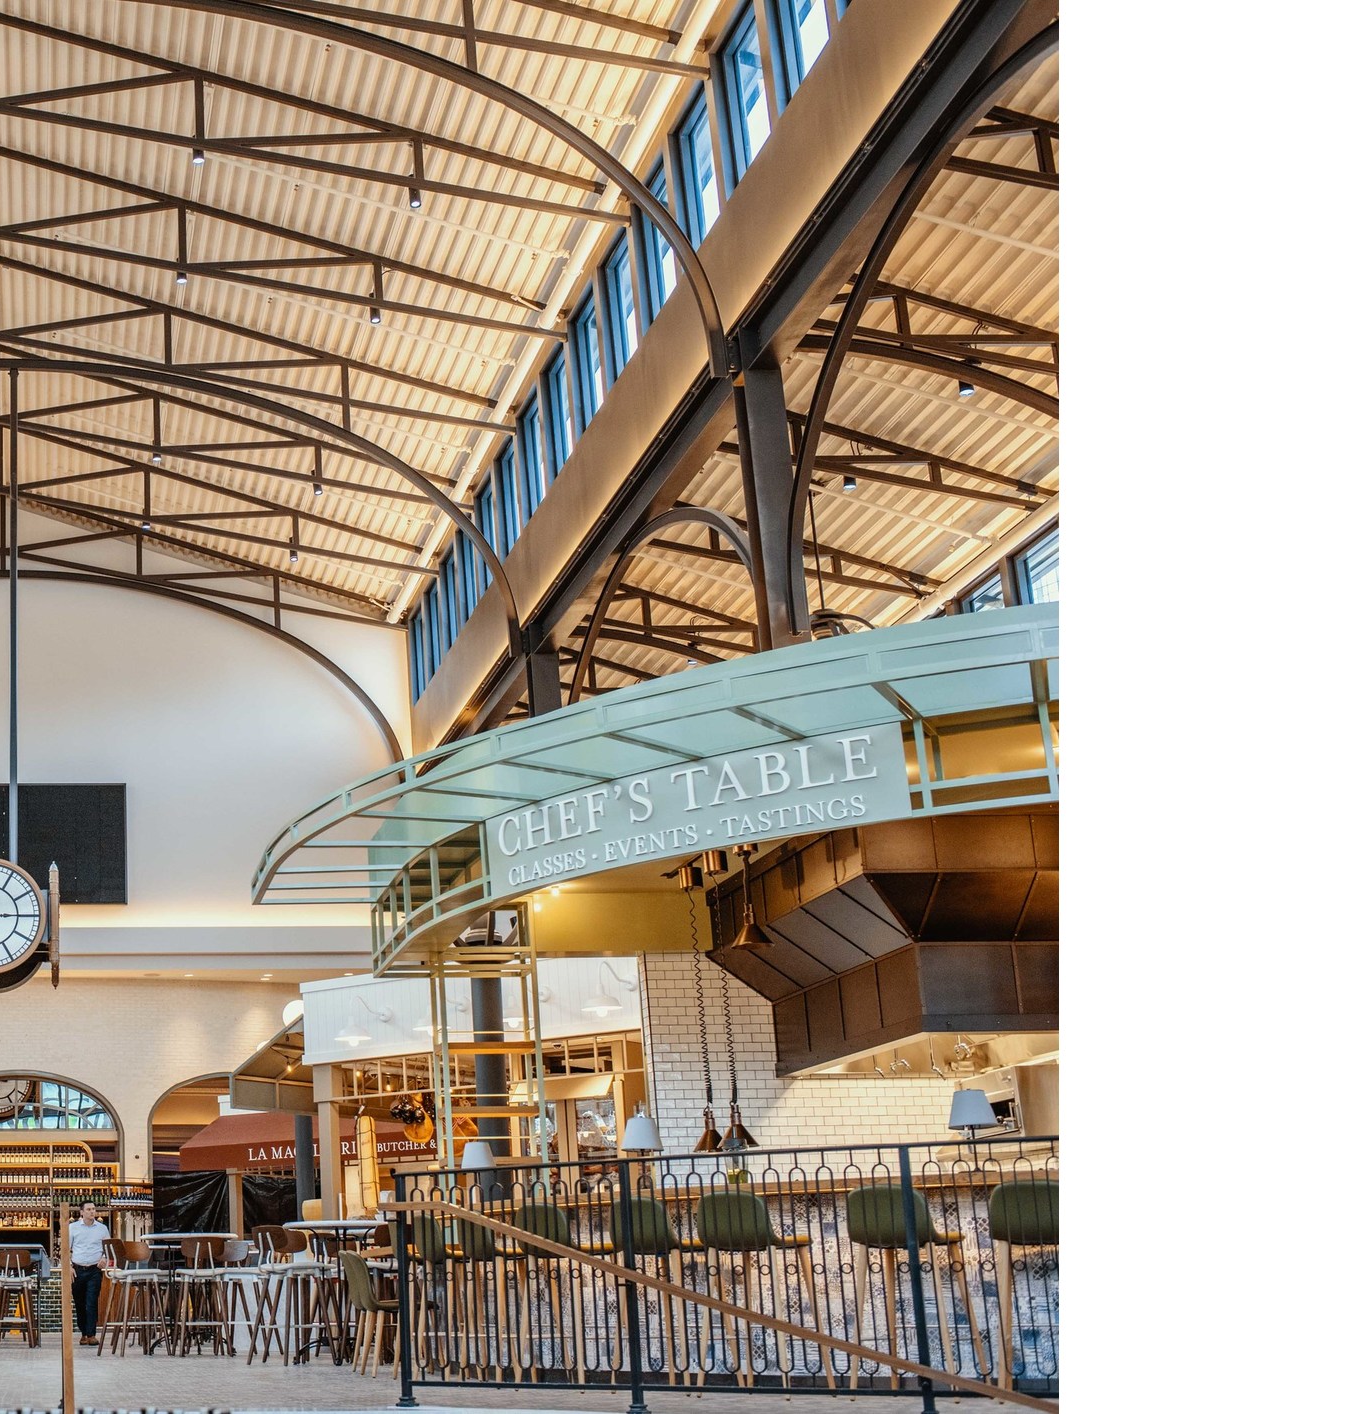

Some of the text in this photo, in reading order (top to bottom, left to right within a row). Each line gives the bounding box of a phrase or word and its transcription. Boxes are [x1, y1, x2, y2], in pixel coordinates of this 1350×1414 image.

[498, 734, 878, 856] CHEF’S TABLE
[508, 794, 867, 886] CLASSES EVENTS TASTINGS
[248, 1147, 268, 1161] LA
[377, 1140, 427, 1153] BUTCHER
[429, 1138, 437, 1149] &
